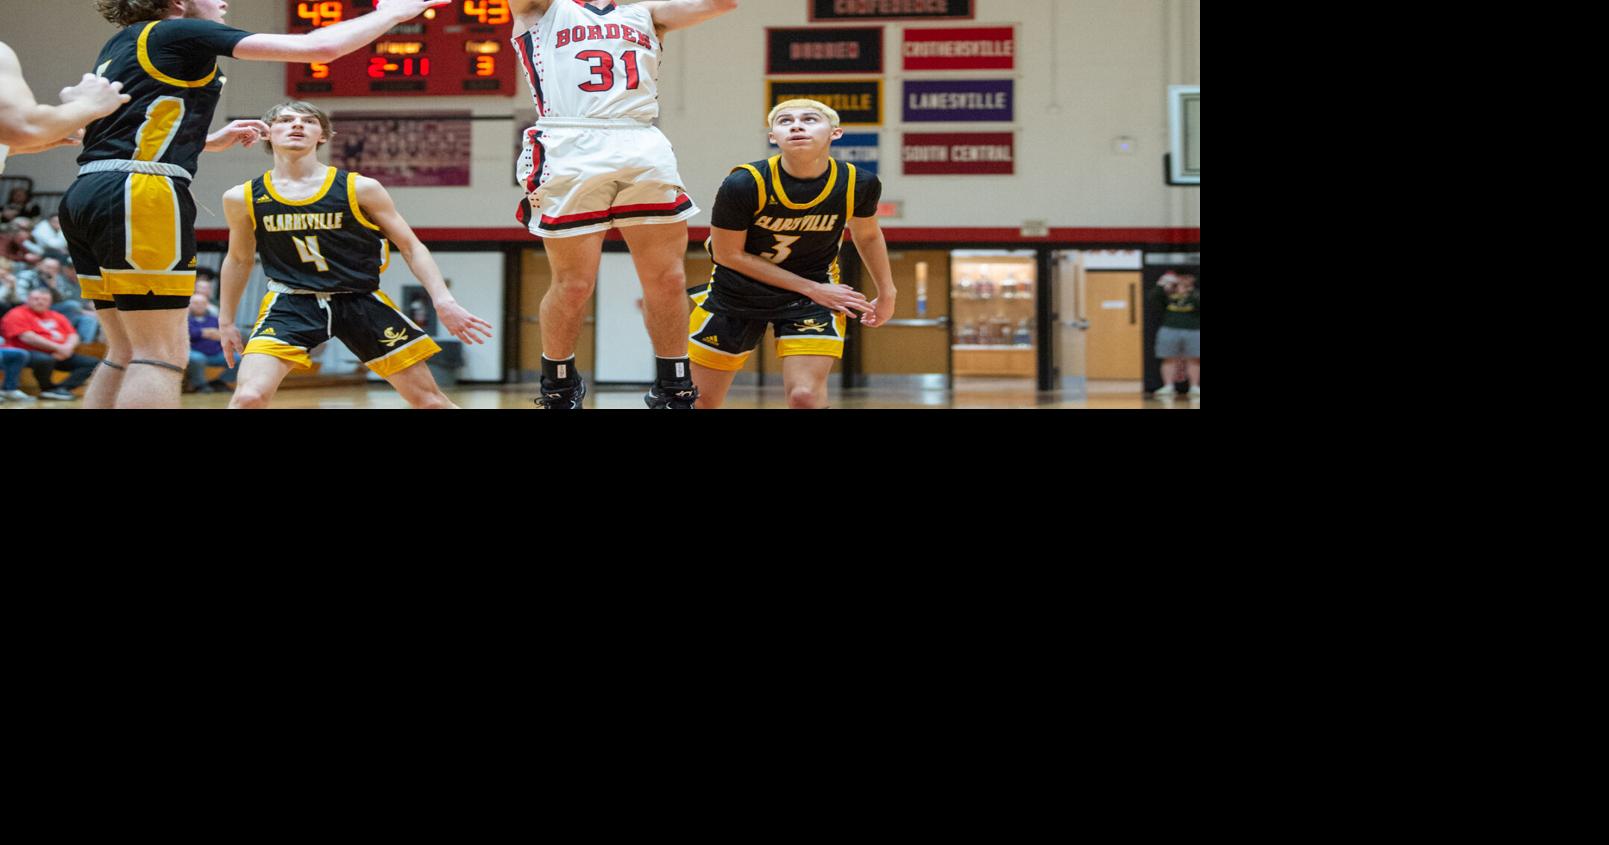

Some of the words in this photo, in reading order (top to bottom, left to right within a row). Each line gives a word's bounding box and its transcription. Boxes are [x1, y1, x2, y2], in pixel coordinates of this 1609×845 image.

[298, 2, 342, 27] 49
[463, 0, 510, 24] 43
[903, 40, 1014, 58] CROTHERSVILLE
[476, 55, 495, 76] 3
[575, 50, 640, 92] 31
[909, 92, 1007, 110] LANESVILLE
[903, 145, 948, 162] SOUTH
[951, 144, 1013, 162] CENTRAL
[291, 235, 329, 272] 4
[760, 233, 801, 264] 3
